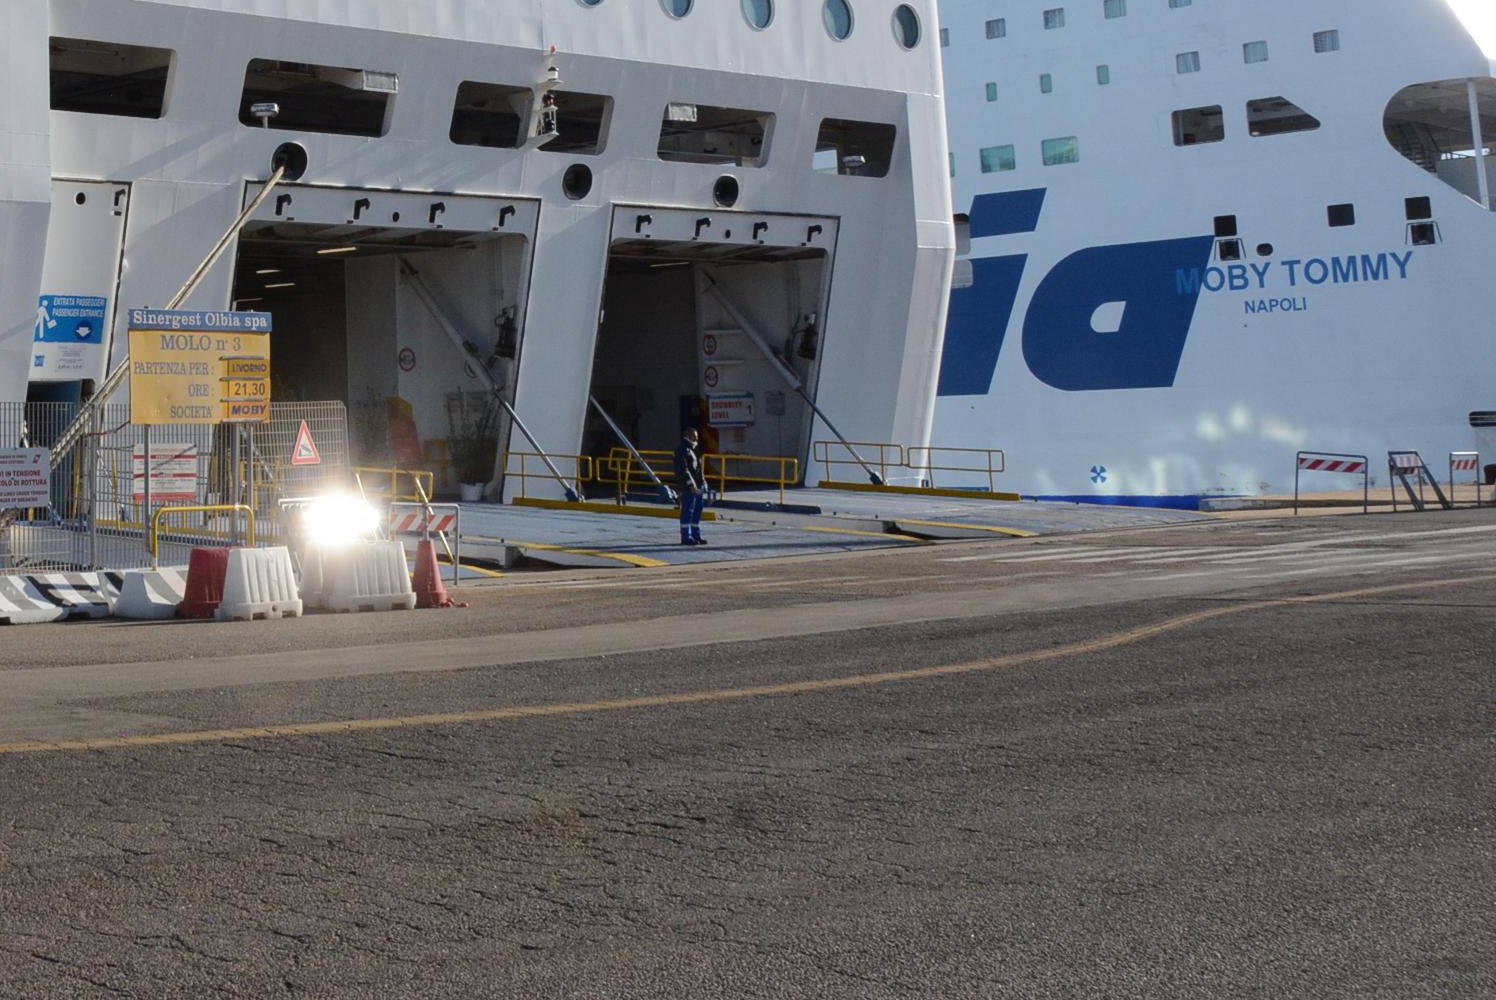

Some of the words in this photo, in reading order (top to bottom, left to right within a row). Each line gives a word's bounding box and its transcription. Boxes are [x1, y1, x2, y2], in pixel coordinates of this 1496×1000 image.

[1175, 262, 1271, 294] MOBY
[1280, 250, 1413, 287] TOMMY
[1244, 297, 1307, 314] NAPOLI
[133, 310, 202, 329] Sinergest
[205, 312, 241, 327] Olbia
[244, 318, 267, 330] spa
[160, 334, 212, 351] MOLO
[233, 336, 242, 351] 3
[134, 361, 186, 375] PARTENZA
[232, 363, 267, 373] LIVORNO
[231, 405, 267, 415] MOBY
[711, 400, 744, 409] SECURITY
[747, 404, 752, 415] 1
[13, 469, 41, 477] TENSIONE
